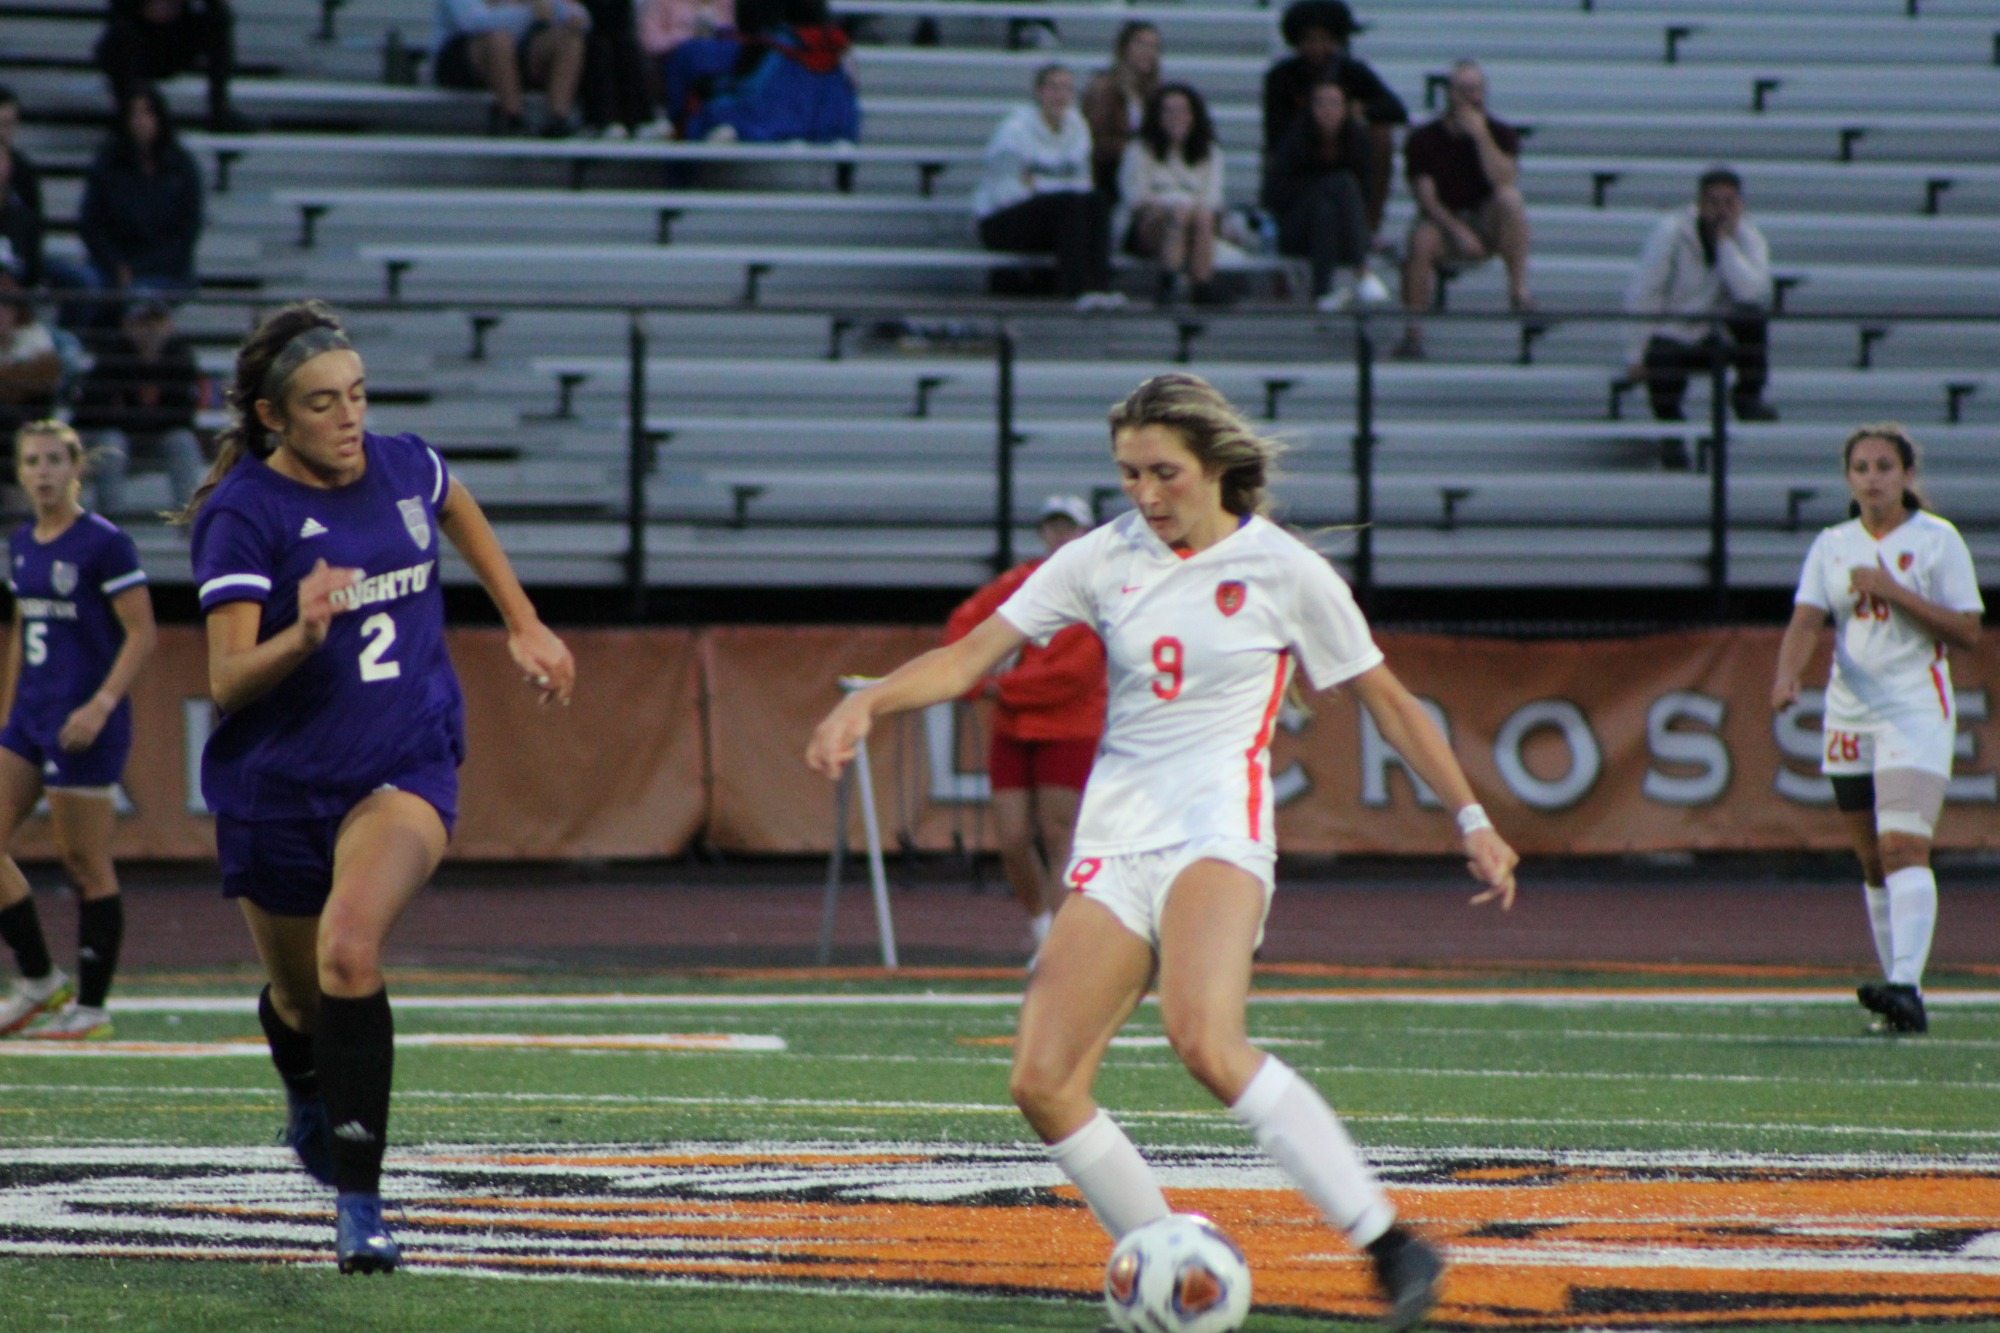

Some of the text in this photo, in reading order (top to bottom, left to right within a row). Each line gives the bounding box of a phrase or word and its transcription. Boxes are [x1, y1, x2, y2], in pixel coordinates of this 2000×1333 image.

[329, 560, 435, 611] OUGHTO
[26, 621, 49, 667] 5
[358, 612, 401, 683] 2
[1152, 635, 1184, 700] 9
[924, 690, 1998, 808] LROSSE
